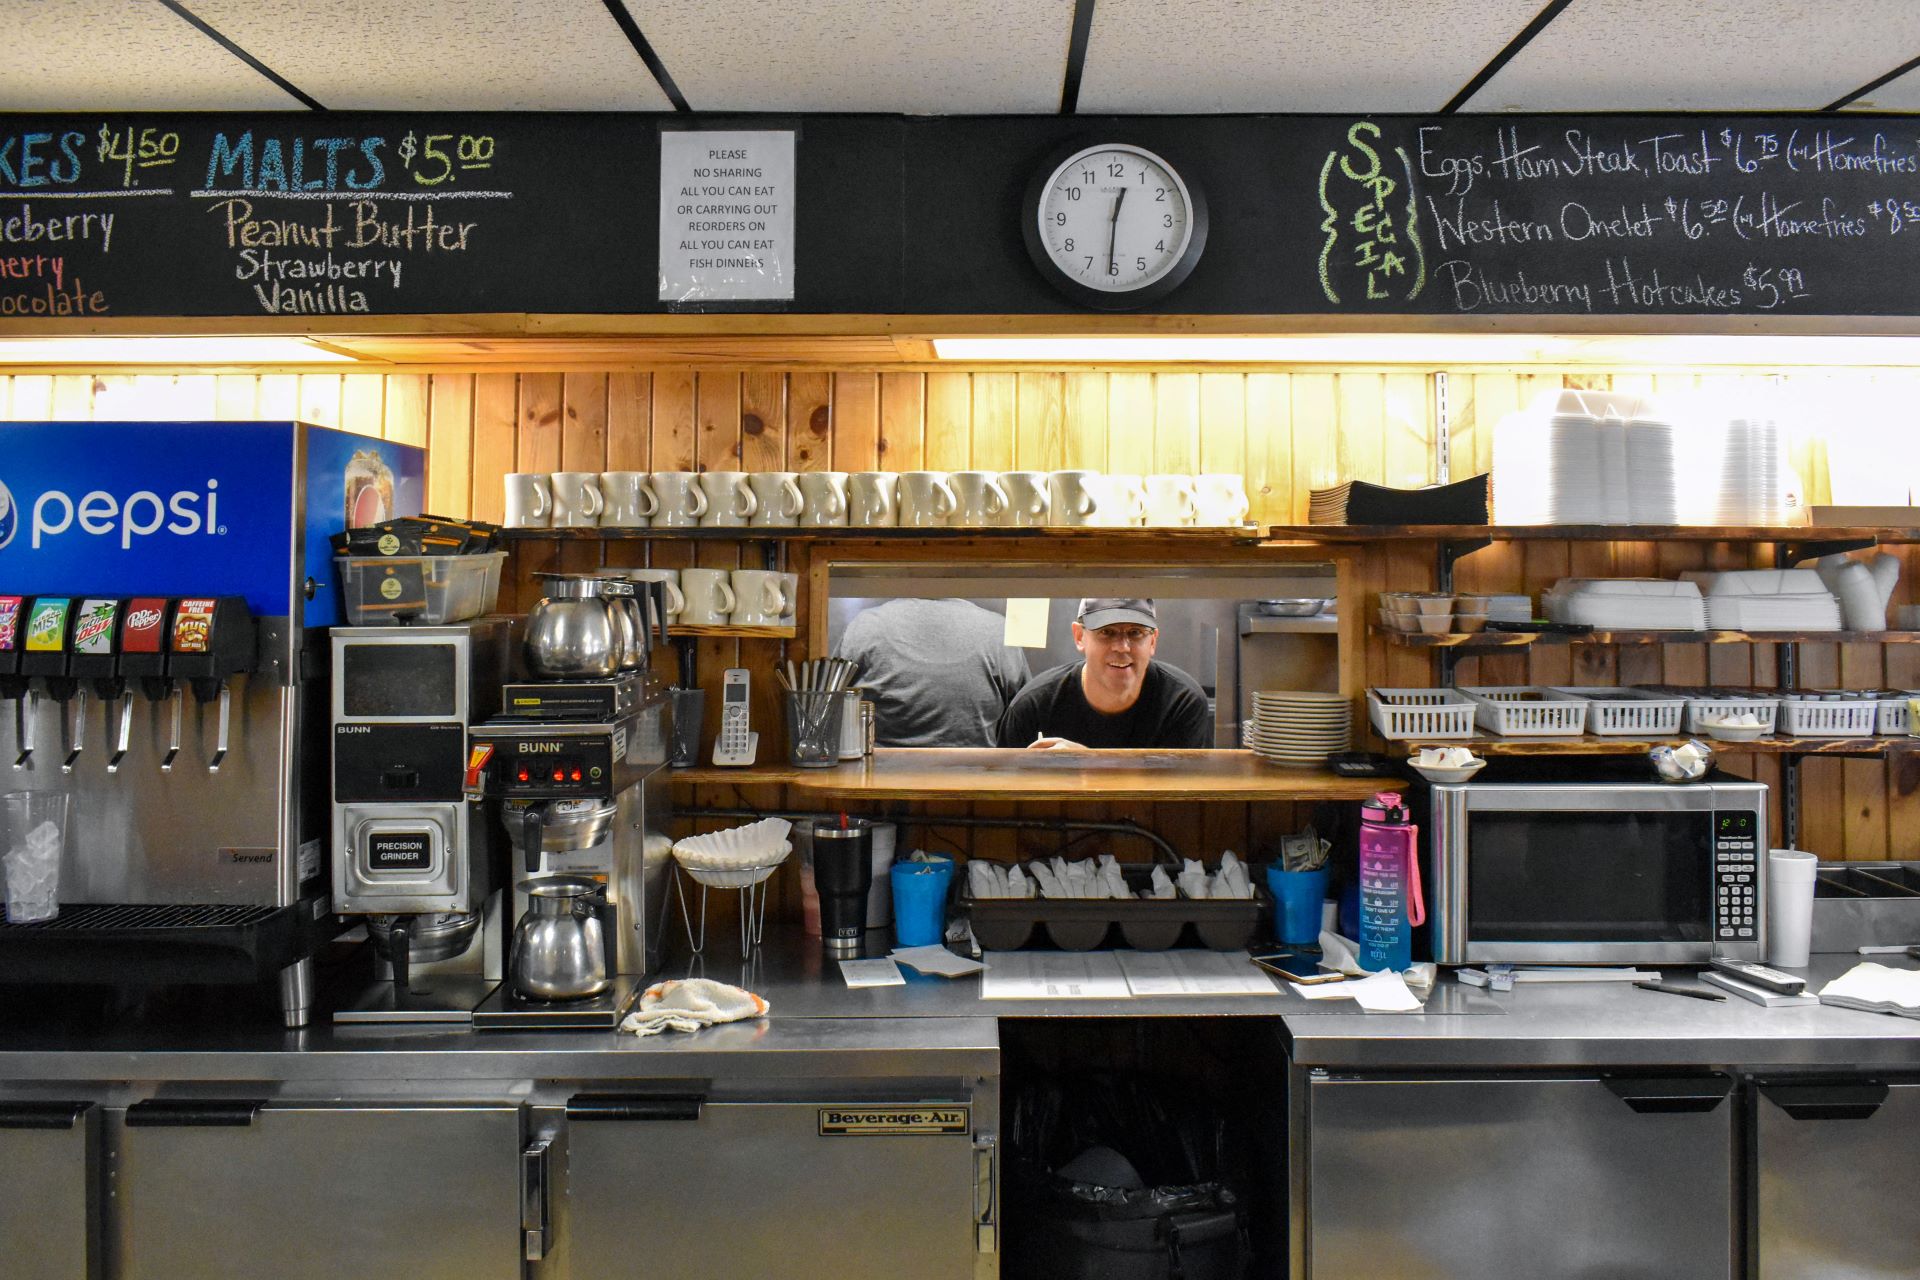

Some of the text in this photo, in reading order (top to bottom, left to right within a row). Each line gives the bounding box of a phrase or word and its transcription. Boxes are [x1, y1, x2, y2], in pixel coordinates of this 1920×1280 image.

[204, 129, 495, 191] MALTS $5.00
[709, 150, 748, 160] PLEASE
[1418, 125, 1491, 196] Eggs,
[1492, 125, 1559, 181] Ham
[1638, 129, 1722, 175] Toast
[693, 168, 763, 178] NO SHARING
[1082, 170, 1096, 184] 11
[1106, 163, 1124, 178] 12
[1138, 171, 1145, 185] 1
[680, 187, 776, 197] ALL YOU CAN EAT
[1065, 187, 1081, 201] 10
[1155, 188, 1165, 202] 2
[677, 205, 779, 215] OR CARRYING OUT
[1340, 121, 1406, 299] SPECIAL
[206, 199, 478, 252] Peanut Butter
[1056, 212, 1066, 226] 9
[1163, 214, 1173, 228] 3
[1425, 195, 1553, 250] Western
[1560, 200, 1664, 241] Omelet
[688, 222, 766, 232] REORDERS ON
[679, 240, 775, 250] ALL YOU CAN EAT
[1064, 238, 1074, 252] 8
[1154, 239, 1165, 253] 4
[235, 249, 402, 288] Strawberry
[689, 258, 764, 268] FISH DINNERS
[1083, 256, 1094, 270] 7
[1109, 262, 1119, 277] 6
[1136, 257, 1146, 271] 5
[1433, 259, 1592, 312] Blueberry
[1599, 255, 1742, 308] Hotcakes
[254, 278, 370, 314] Vanilla
[32, 478, 218, 549] pepsi
[182, 600, 215, 608] CAFFEINE
[130, 612, 159, 628] Pepper
[140, 609, 153, 619] Dr
[32, 614, 61, 633] MIST
[179, 621, 208, 635] MUG
[337, 726, 371, 734] BUNN
[518, 742, 561, 754] BUNN
[376, 842, 423, 850] PRECISION
[232, 853, 274, 864] Servend
[380, 852, 419, 860] GRINDER
